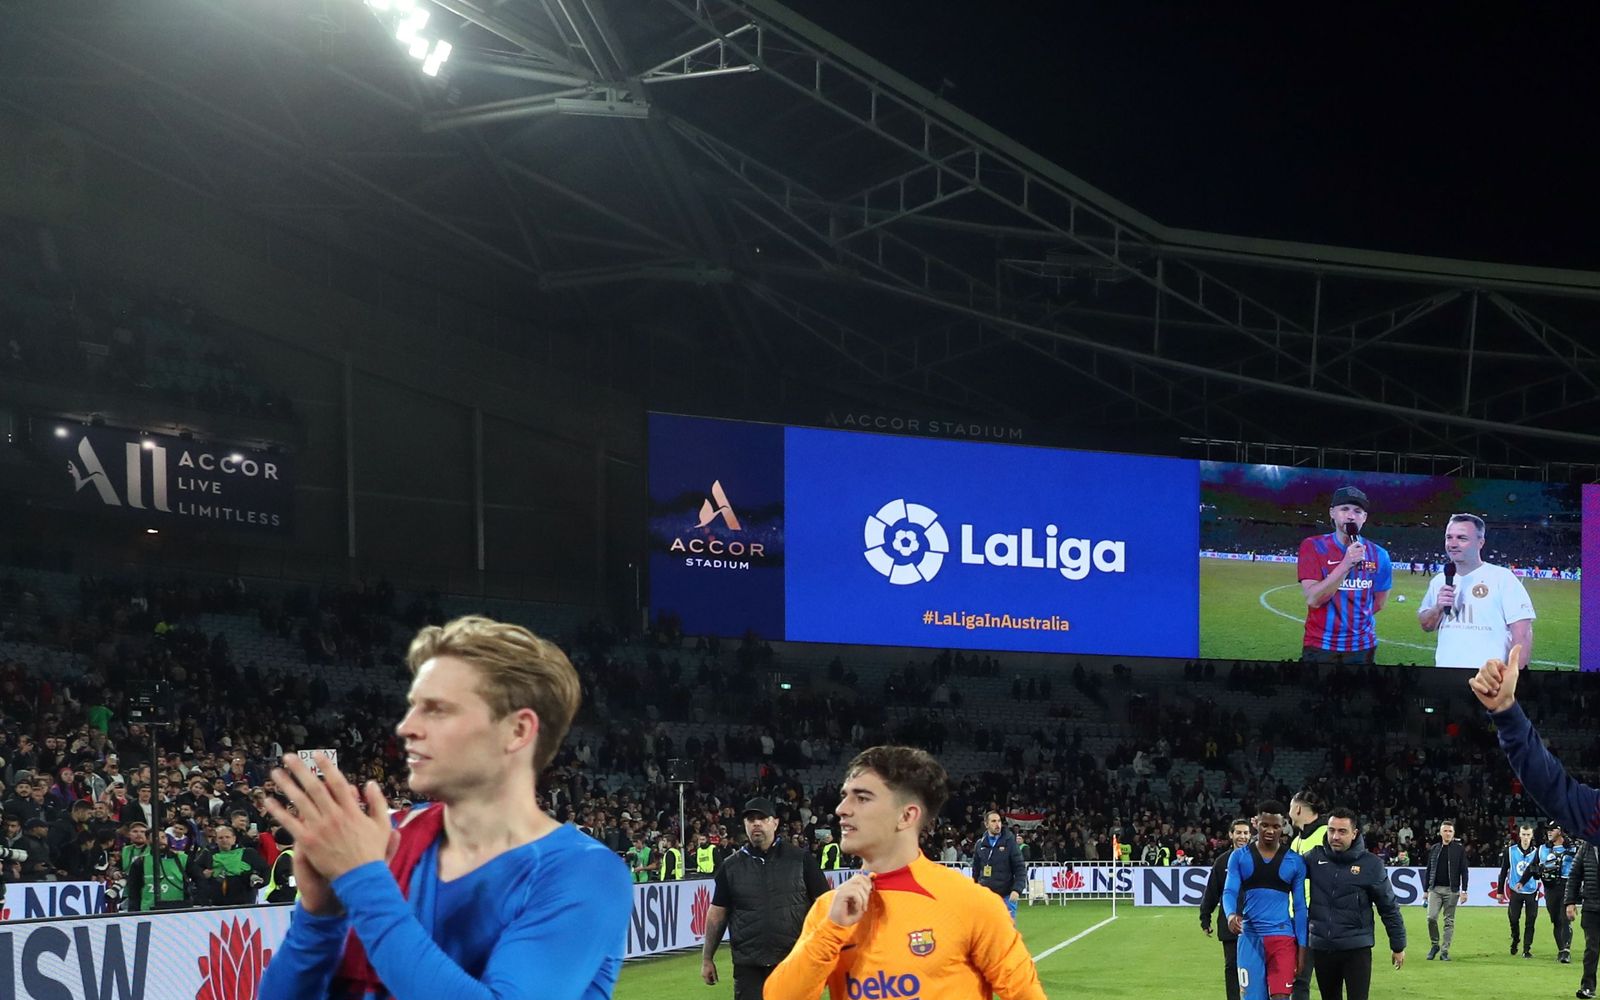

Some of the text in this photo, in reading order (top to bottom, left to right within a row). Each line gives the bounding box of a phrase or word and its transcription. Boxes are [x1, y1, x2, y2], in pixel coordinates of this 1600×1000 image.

[844, 414, 1023, 439] ACCOR STADIUM
[178, 450, 279, 480] ACCOR
[178, 477, 222, 494] LIVE
[178, 502, 280, 527] LIMITLESS
[670, 538, 765, 557] ACCOR
[961, 524, 1126, 580] LaLiga
[686, 558, 749, 570] STADIUM
[922, 610, 1070, 632] #LaLigaInAustralia
[1093, 868, 1134, 891] NS
[1144, 868, 1211, 904] NS
[627, 884, 680, 954] NSW
[845, 970, 921, 1000] beko
